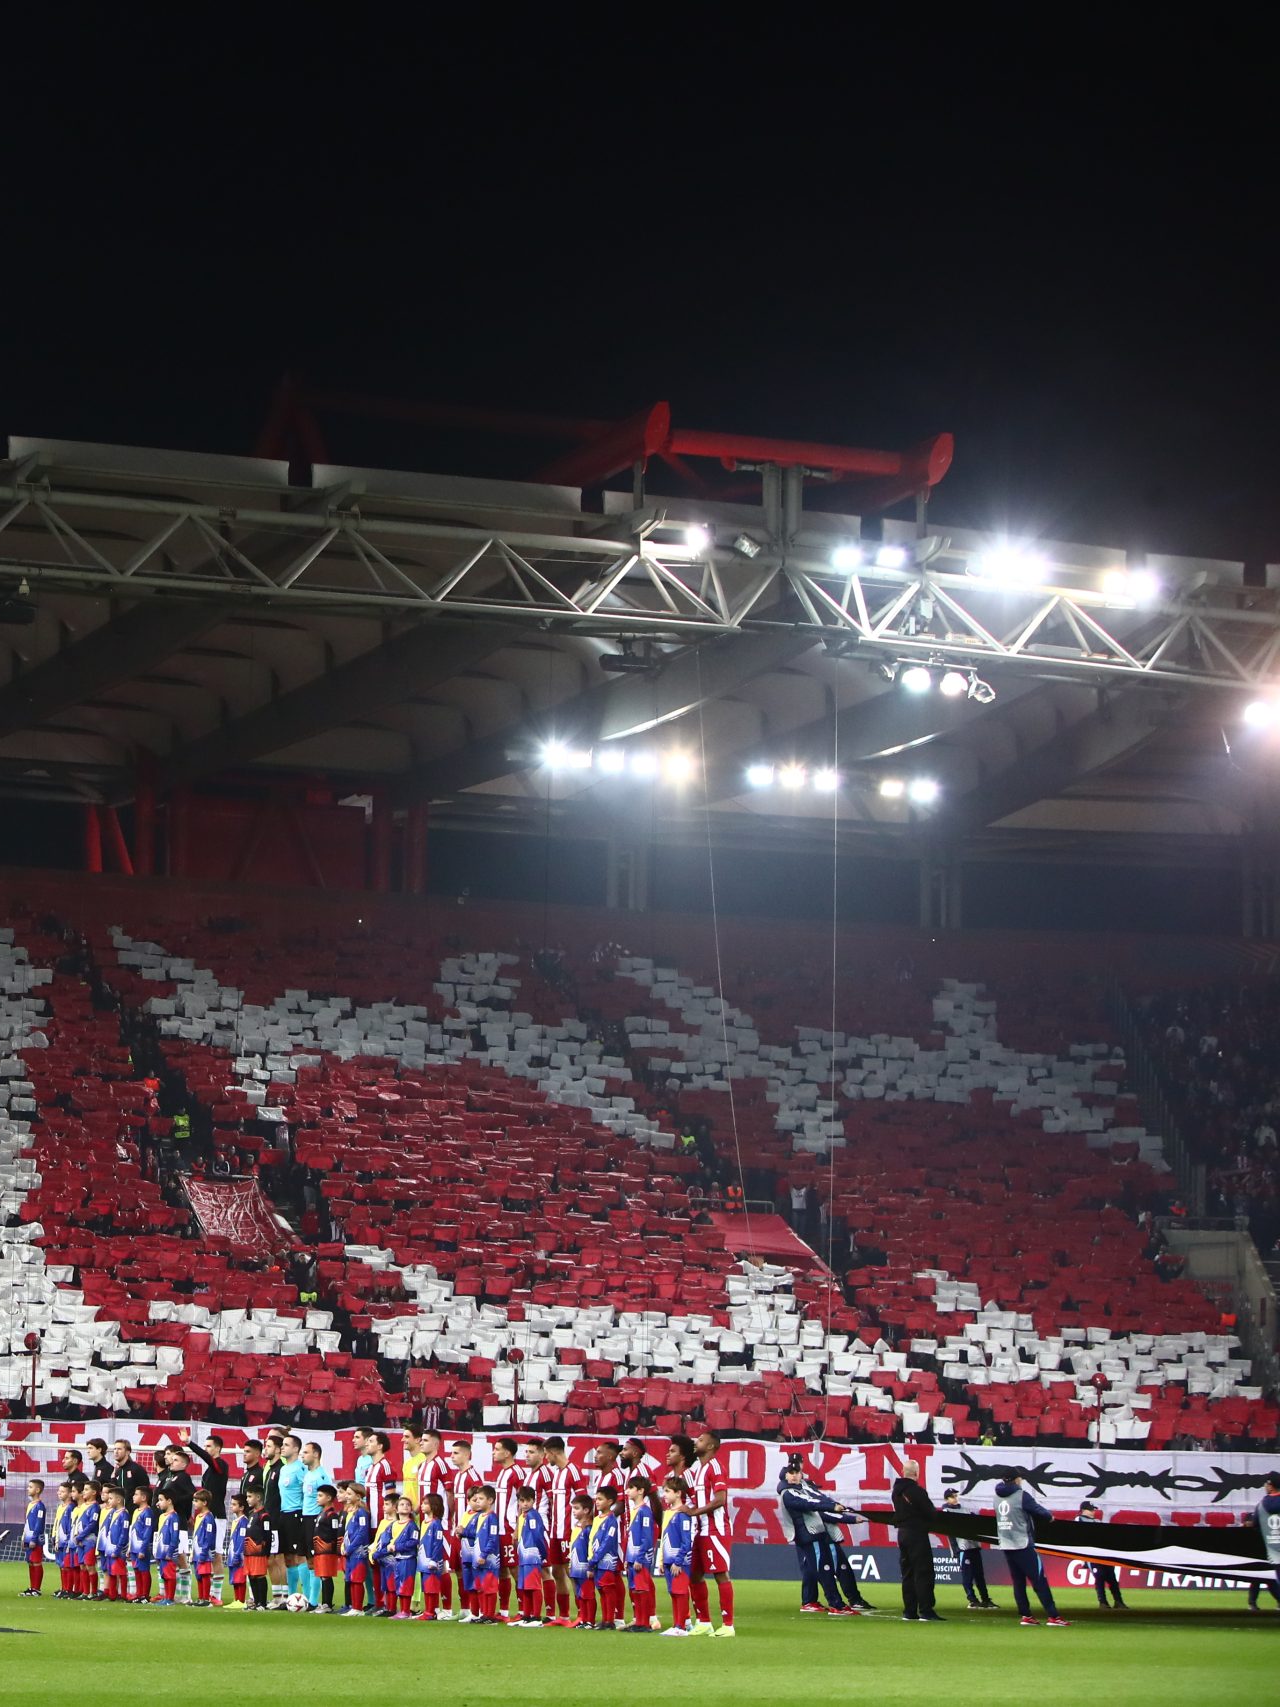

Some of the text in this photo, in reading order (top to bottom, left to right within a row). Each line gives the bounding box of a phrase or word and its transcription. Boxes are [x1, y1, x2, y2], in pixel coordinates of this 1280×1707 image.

[503, 1544, 515, 1558] 32
[706, 1549, 714, 1563] 9
[847, 1554, 881, 1580] FA
